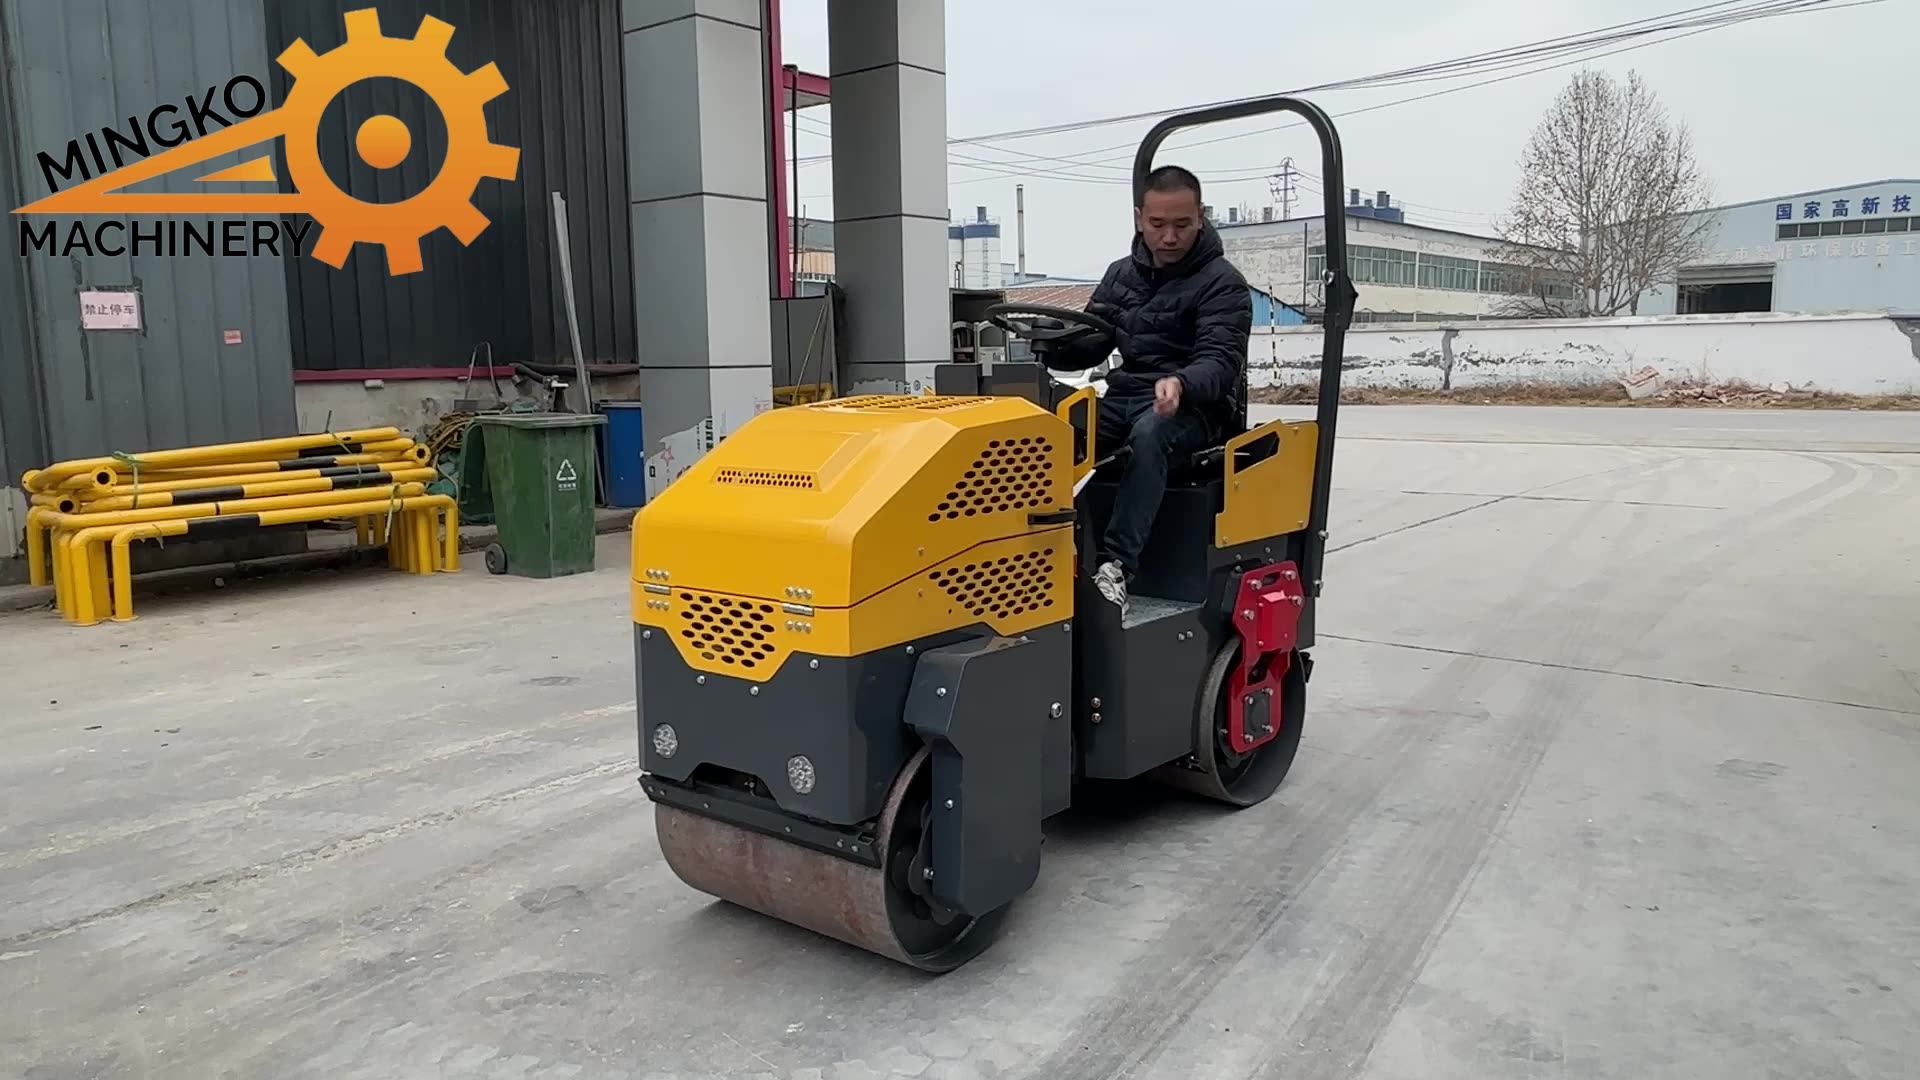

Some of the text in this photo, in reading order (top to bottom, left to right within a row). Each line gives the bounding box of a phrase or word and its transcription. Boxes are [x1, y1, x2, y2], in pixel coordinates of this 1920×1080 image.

[1775, 194, 1911, 221] 国家高新技
[85, 303, 135, 315] 禁止停车
